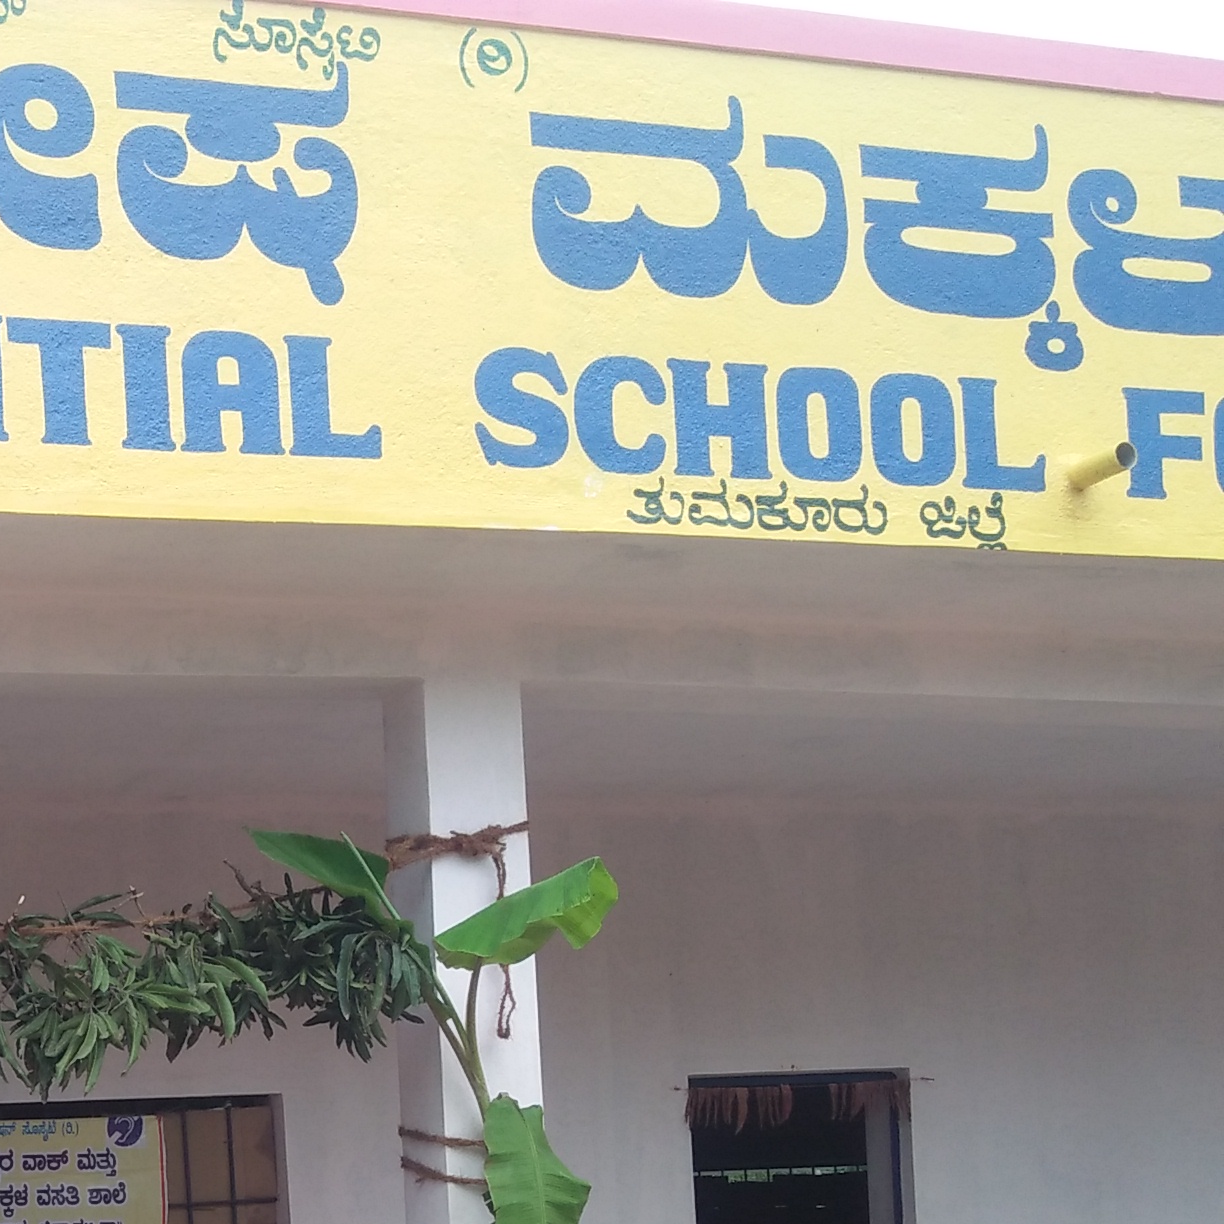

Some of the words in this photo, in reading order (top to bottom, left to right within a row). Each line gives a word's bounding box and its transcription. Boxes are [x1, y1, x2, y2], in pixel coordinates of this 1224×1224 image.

[475, 347, 1046, 492] SCHOOL
[1122, 387, 1224, 500] F
[627, 477, 888, 535] ತುಮಕೂರು
[919, 492, 1007, 550] ಜಿಲ್ಲೆ
[22, 1150, 69, 1172] ವಾಕ್
[77, 1148, 117, 1177] ಮತ್ತು
[36, 1183, 81, 1207] ವಸತಿ
[87, 1182, 127, 1205] ಶಾಲೆ
